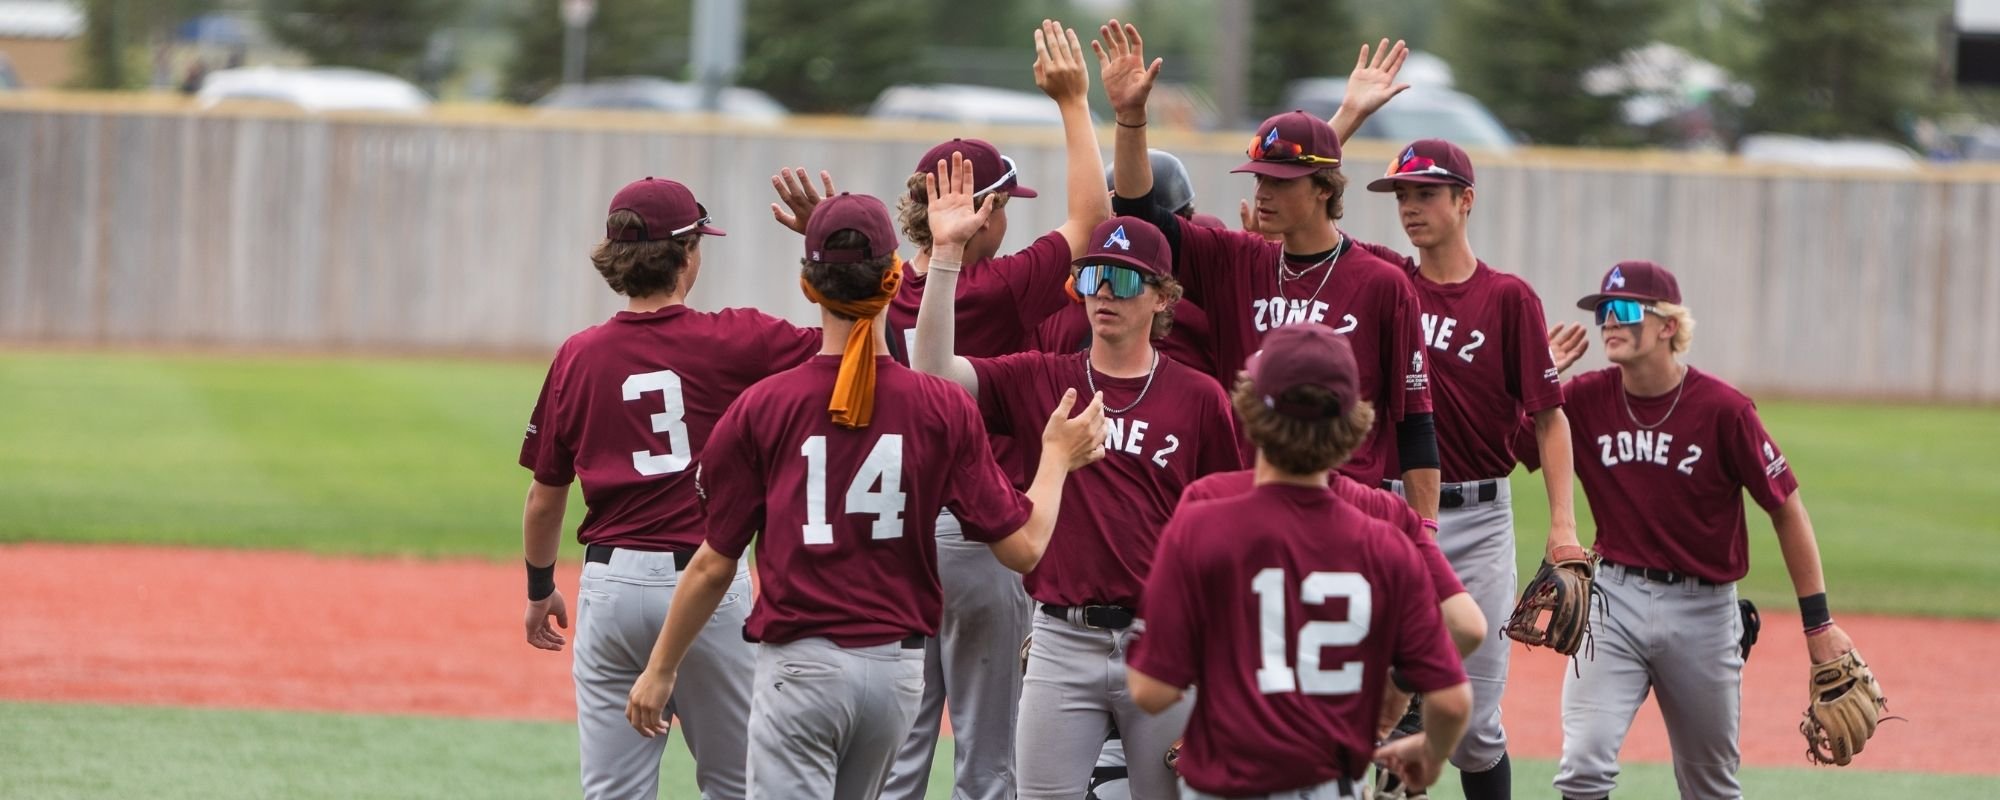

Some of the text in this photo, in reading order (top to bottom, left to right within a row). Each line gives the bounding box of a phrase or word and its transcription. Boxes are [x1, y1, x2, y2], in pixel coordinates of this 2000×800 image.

[1103, 225, 1131, 250] A
[1605, 266, 1626, 290] A
[1253, 296, 1358, 335] ZONE 2
[1421, 313, 1485, 363] NE 2
[621, 369, 692, 477] 3
[1104, 417, 1180, 469] NE 2
[1597, 429, 1703, 476] ZONE 2
[801, 433, 907, 545] 14
[1251, 567, 1372, 695] 12
